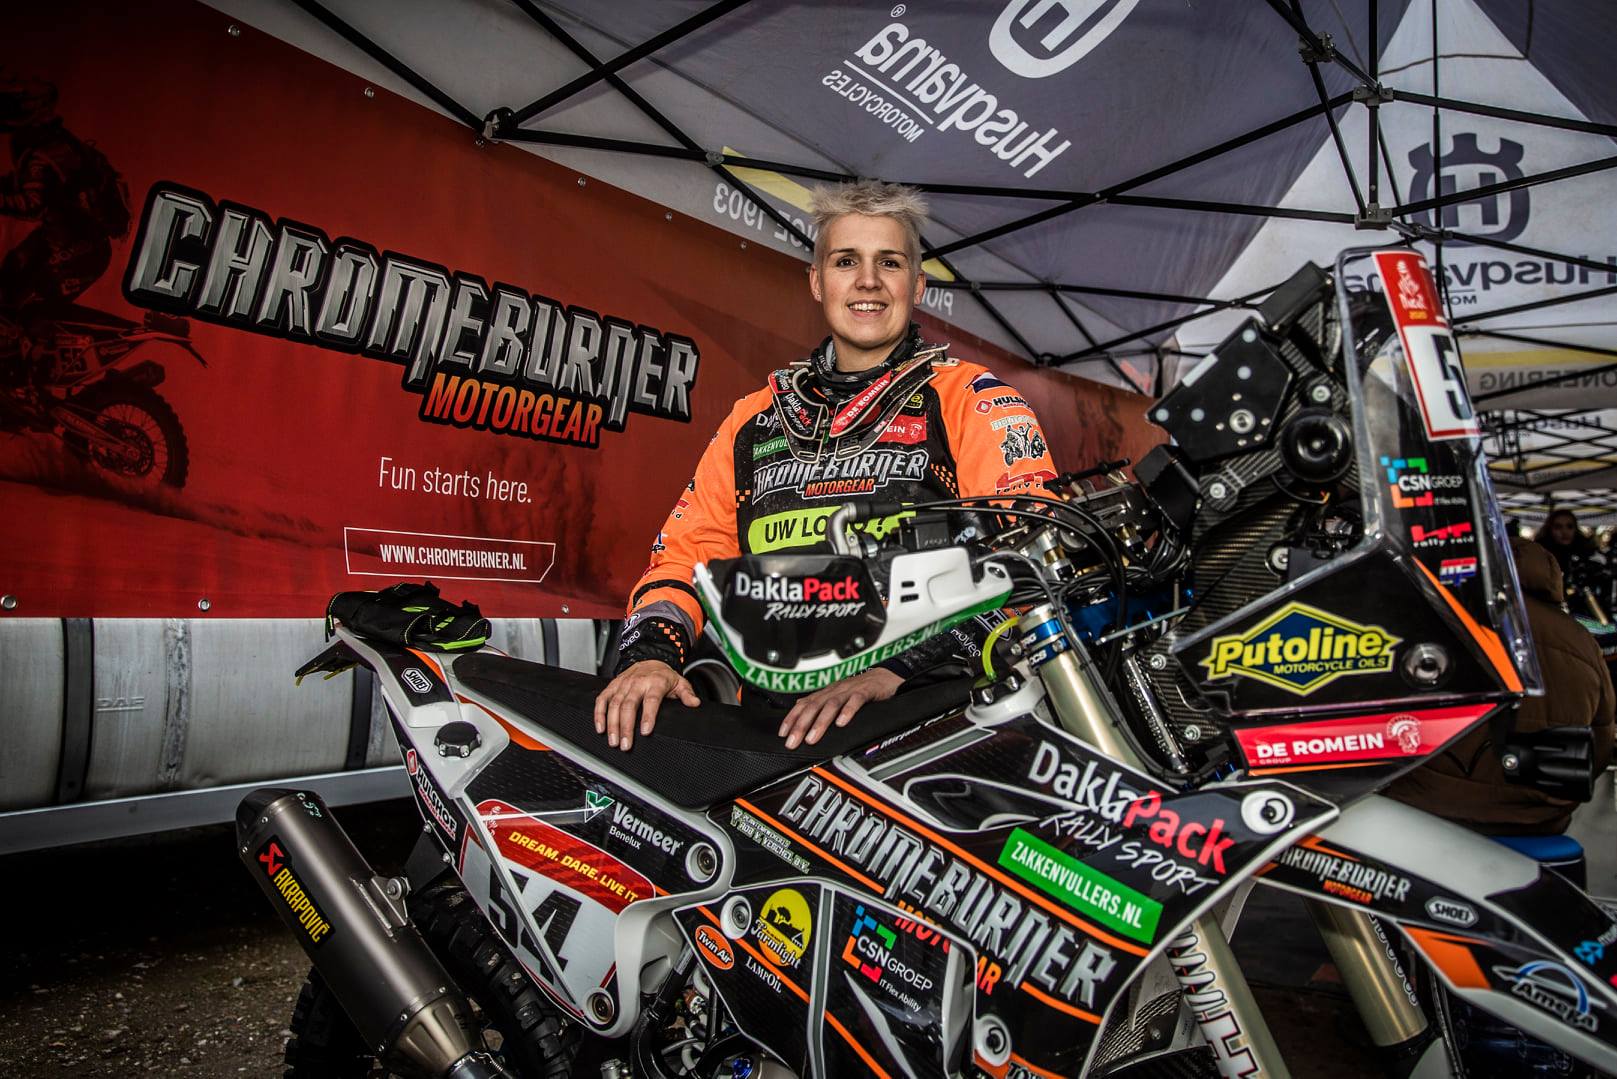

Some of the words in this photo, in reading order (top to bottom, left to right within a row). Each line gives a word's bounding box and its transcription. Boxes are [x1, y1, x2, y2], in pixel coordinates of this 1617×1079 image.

[131, 190, 699, 427] CHROMEBURNER
[424, 371, 603, 445] MOTORGEAR
[379, 456, 416, 493] Fun
[423, 465, 480, 500] starts
[486, 469, 533, 504] here.
[805, 478, 876, 498] MOTORGEAR
[764, 517, 797, 543] UW
[801, 515, 829, 538] LO
[380, 543, 528, 571] WWW.CHROMEBURNER.NL
[735, 572, 860, 602] DaklaPack
[1216, 627, 1387, 673] Putoline
[1273, 660, 1354, 675] MOTORCYCLE
[1358, 657, 1386, 669] OILS
[405, 670, 428, 690] SHOEI
[1256, 742, 1288, 758] DE
[1293, 733, 1384, 756] ROMEIN
[416, 763, 457, 834] HULSHOF
[1028, 740, 1235, 874] DaklaPack
[609, 825, 641, 850] Benelux
[613, 802, 680, 856] Vermeer
[508, 831, 559, 861] DREAM.
[560, 855, 599, 880] DARE.
[599, 874, 627, 896] LIVE
[624, 890, 638, 903] IT
[1010, 840, 1143, 929] ZAKKENVULLERS.NL
[1275, 846, 1412, 902] HROMEBURNER
[778, 774, 1117, 1009] CHROMEBURNER
[1434, 901, 1471, 923] SHOEI
[699, 930, 718, 953] Twin
[716, 950, 732, 963] Air
[898, 990, 922, 1013] Ability
